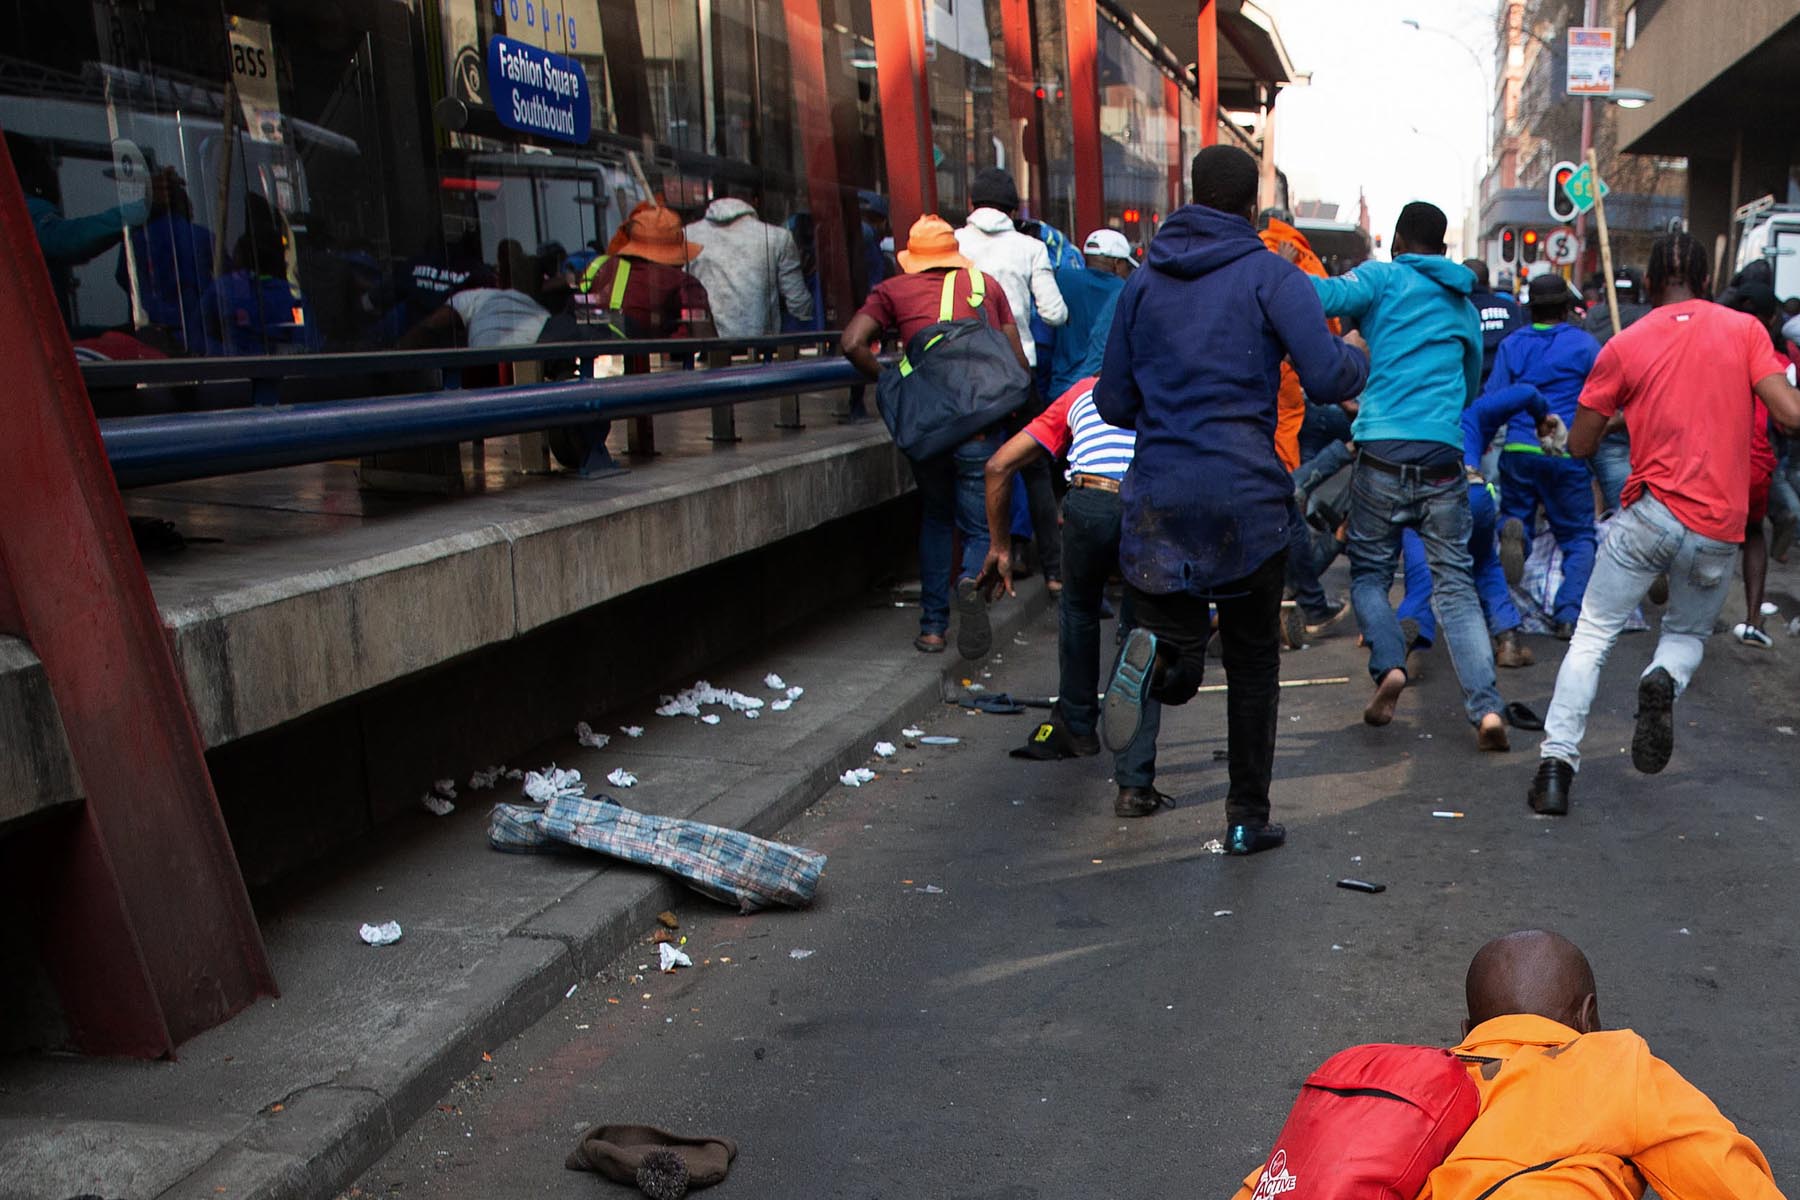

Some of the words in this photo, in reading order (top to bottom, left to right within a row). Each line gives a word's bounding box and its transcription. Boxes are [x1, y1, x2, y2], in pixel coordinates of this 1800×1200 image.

[498, 42, 543, 88] Fashion
[543, 57, 579, 100] Square
[512, 88, 575, 135] Southbound
[1481, 307, 1510, 320] STEEL
